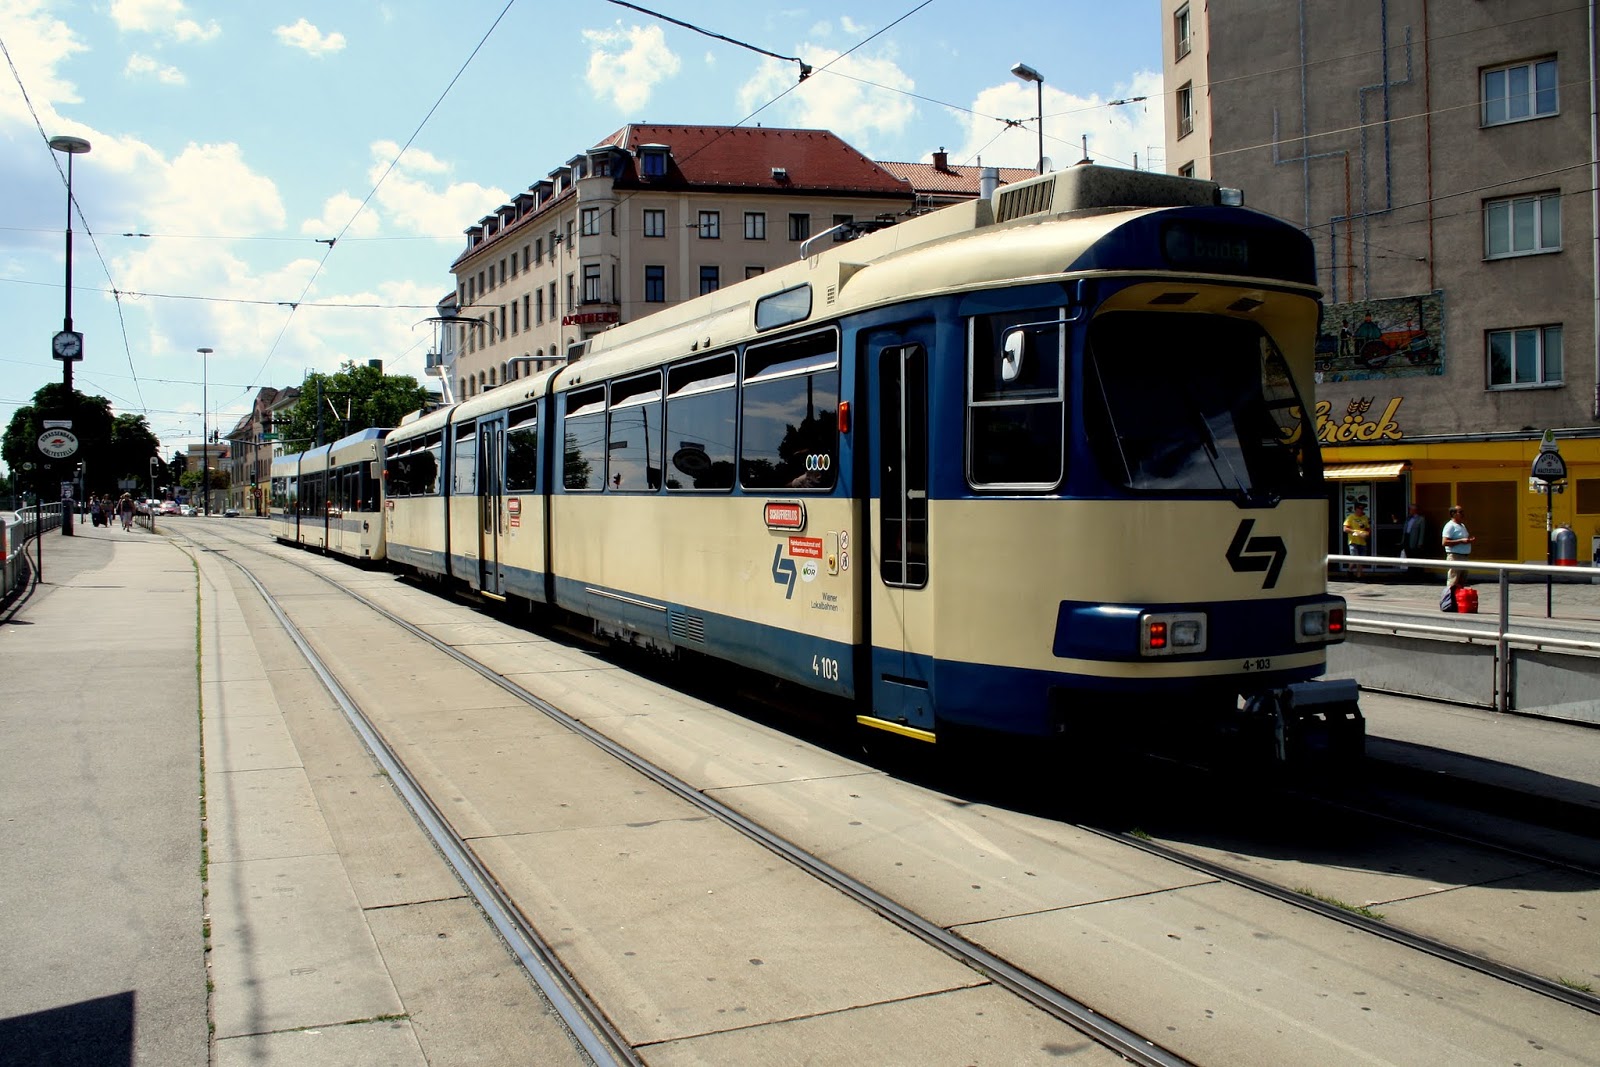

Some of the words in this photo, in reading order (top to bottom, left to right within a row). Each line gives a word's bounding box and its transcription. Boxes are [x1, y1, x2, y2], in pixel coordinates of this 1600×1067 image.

[562, 312, 619, 326] APOTHEKE
[42, 447, 74, 457] HALTESTELLE
[822, 592, 838, 601] Wiener
[811, 600, 838, 611] Lokalbahnen
[812, 655, 819, 676] 4
[821, 657, 838, 680] 103
